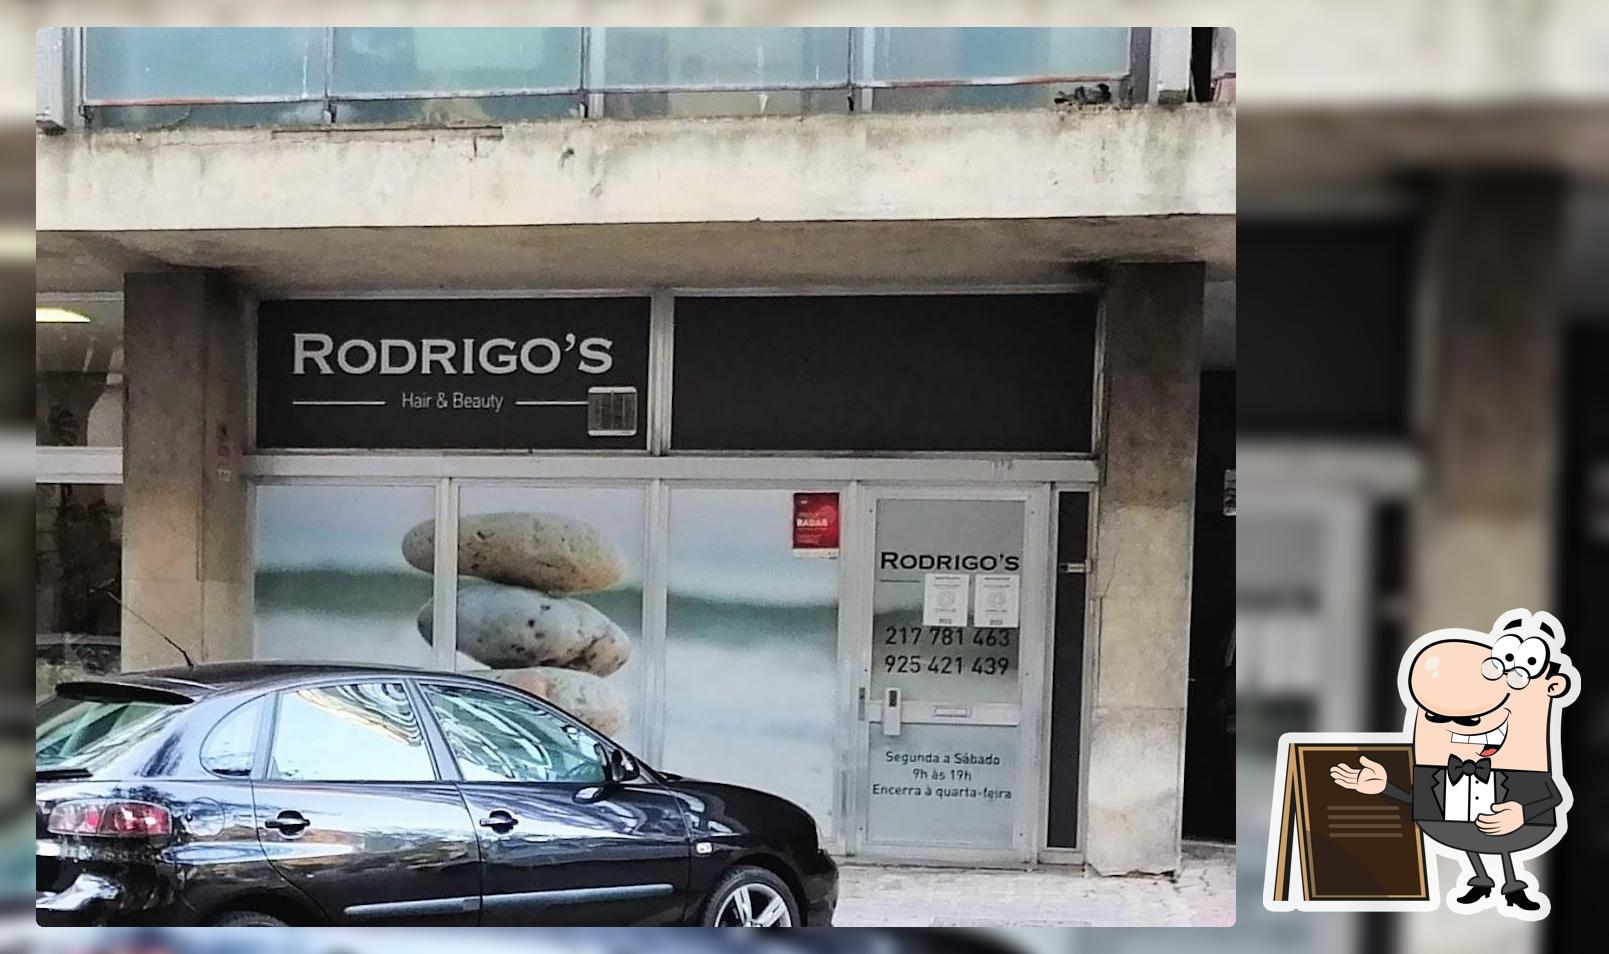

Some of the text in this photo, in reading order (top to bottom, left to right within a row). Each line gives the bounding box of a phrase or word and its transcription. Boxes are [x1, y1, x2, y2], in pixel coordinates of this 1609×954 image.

[291, 332, 614, 375] RODRIGO'S
[402, 393, 504, 413] Hair & Beauty
[880, 552, 1020, 571] RODRIGO'S
[885, 627, 1010, 647] 217 781 463
[885, 655, 1009, 675] 925 421 439
[886, 751, 1000, 765] Segunda a Sábado
[913, 769, 972, 781] 9h às 19h
[873, 784, 1012, 800] Encerra à quarta-feira
